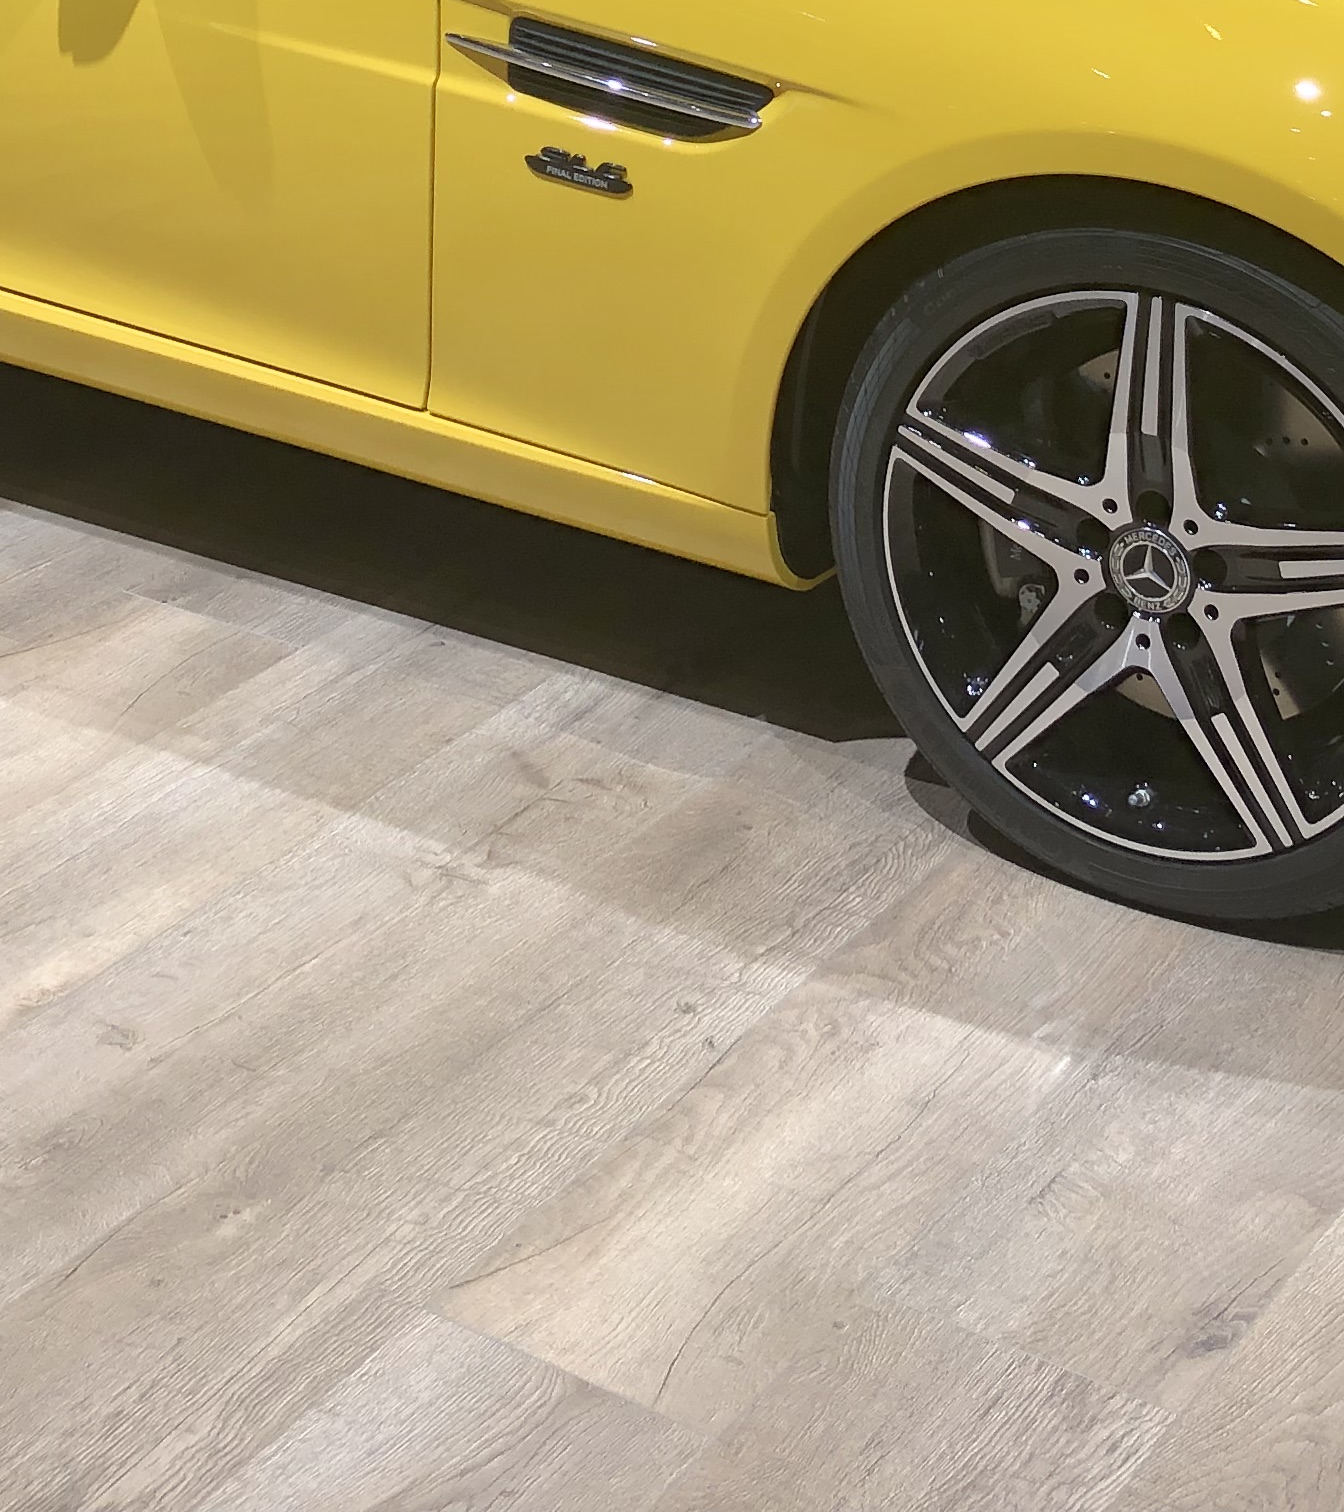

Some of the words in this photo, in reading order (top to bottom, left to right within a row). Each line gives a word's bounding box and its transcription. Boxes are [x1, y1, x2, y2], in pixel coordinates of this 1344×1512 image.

[546, 165, 572, 180] FINAL
[573, 172, 608, 189] EDITION
[1124, 531, 1177, 556] MERCEDES
